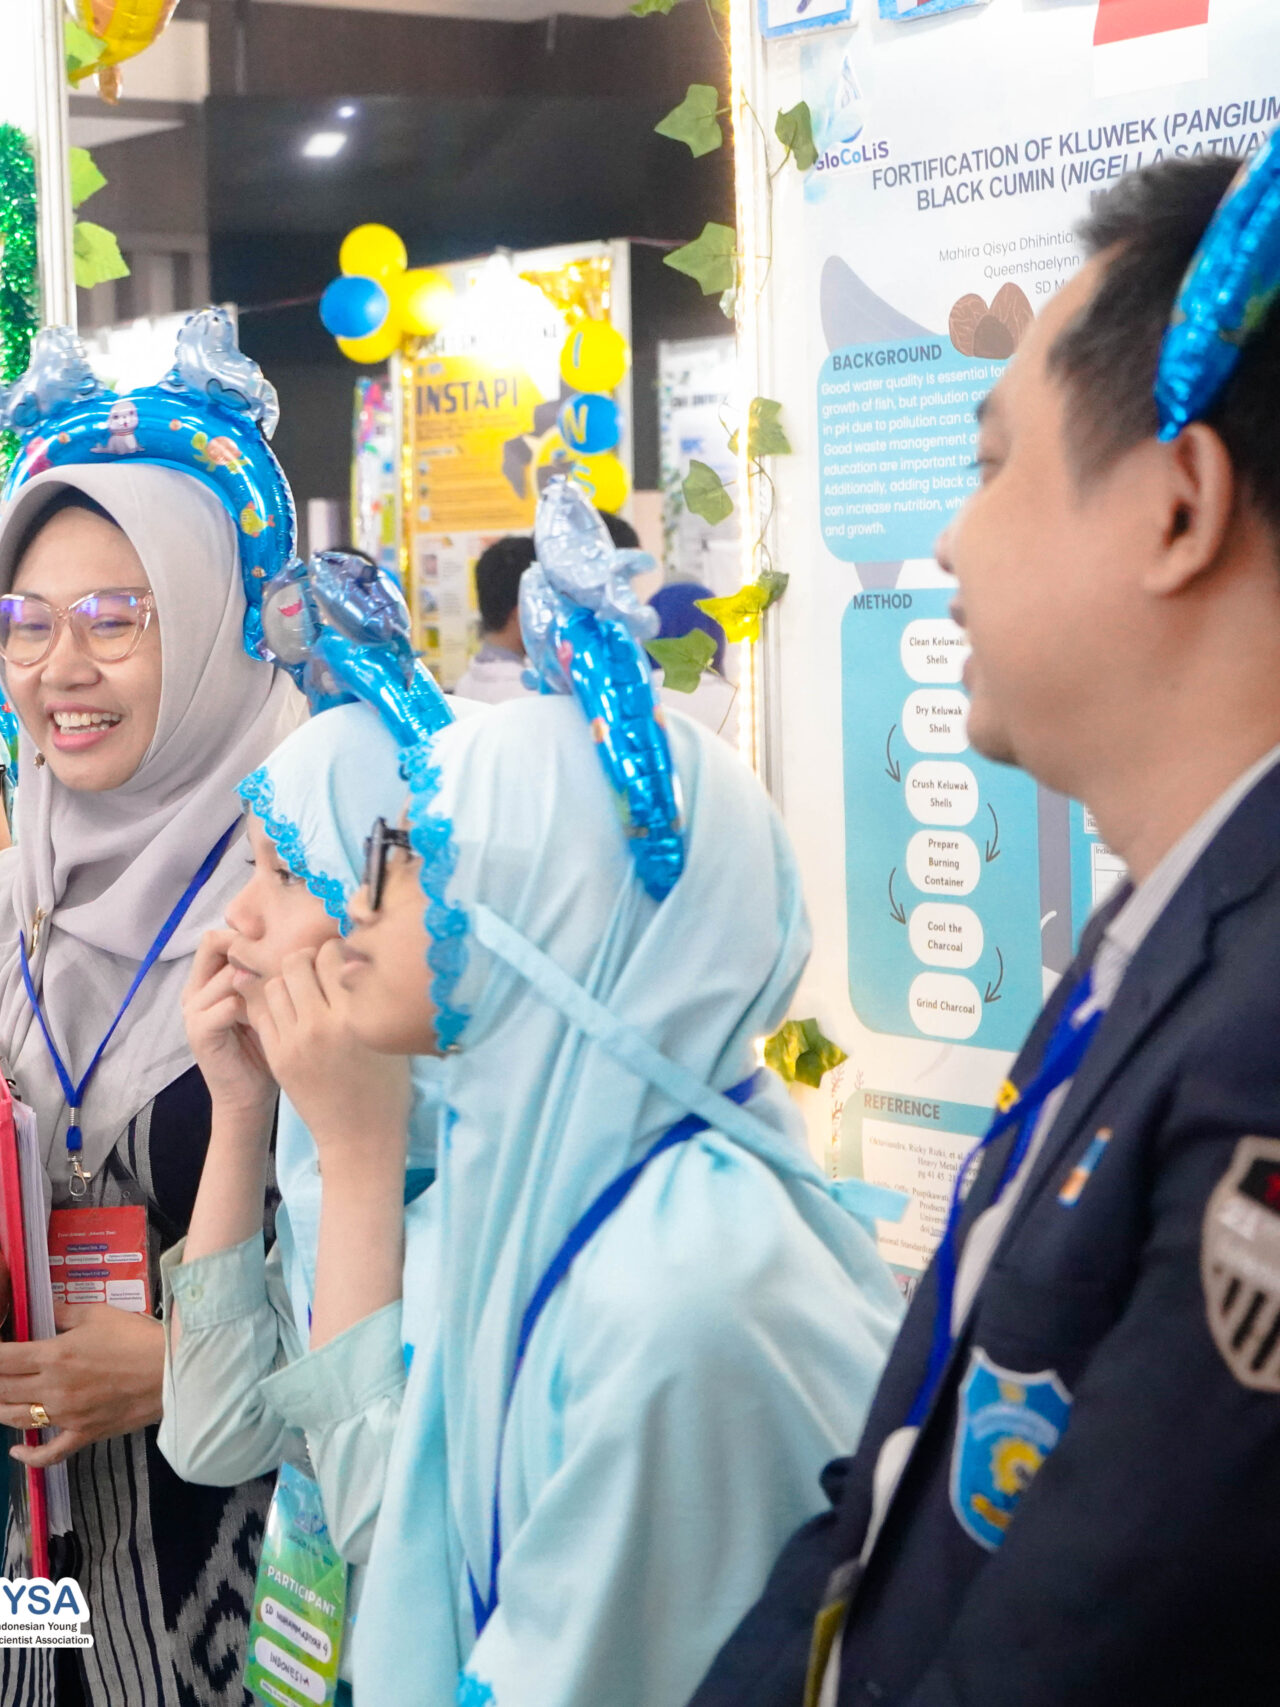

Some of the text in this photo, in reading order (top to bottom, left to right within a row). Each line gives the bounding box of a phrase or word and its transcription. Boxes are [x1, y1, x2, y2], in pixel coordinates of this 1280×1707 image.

[872, 142, 1019, 190] FORTIFICATION
[1024, 137, 1053, 162] OF
[1059, 117, 1157, 156] KLUWEK
[917, 179, 984, 211] BLACK
[989, 167, 1055, 198] CUMIN
[939, 246, 980, 262] Mahira
[983, 240, 1016, 257] Qisya
[983, 254, 1080, 280] Queenshaelynn
[1035, 281, 1052, 295] SD
[832, 344, 943, 371] BACKGROUND
[821, 381, 850, 396] Good
[852, 378, 883, 392] water
[886, 373, 924, 389] quality
[926, 373, 935, 385] is
[937, 365, 989, 384] essential
[415, 377, 518, 416] INSTAPI
[822, 398, 860, 418] growth
[861, 397, 873, 412] of
[898, 394, 917, 408] but
[920, 390, 968, 410] pollution
[823, 421, 833, 436] in
[835, 420, 850, 438] pH
[852, 418, 872, 433] due
[875, 418, 886, 432] to
[889, 413, 937, 434] pollution
[939, 413, 961, 426] can
[824, 442, 852, 457] Good
[854, 440, 887, 454] waste
[889, 433, 967, 452] management
[824, 454, 970, 476] education are important to
[890, 478, 929, 494] adding
[932, 475, 963, 489] black
[824, 505, 844, 517] can
[846, 502, 891, 514] increase
[894, 498, 942, 513] nutrition,
[825, 523, 845, 537] and
[853, 593, 913, 610] METHOD
[909, 637, 930, 647] Clean
[926, 655, 948, 665] Shells
[916, 705, 963, 717] Dry Keluwak
[929, 724, 951, 734] Shells
[912, 779, 969, 791] Crush Keluwak
[930, 798, 952, 808] Shells
[928, 838, 959, 852] Prepare
[928, 857, 960, 871] Burning
[924, 875, 964, 888] Container
[927, 921, 963, 934] Cool the
[927, 939, 963, 953] Charcoal
[916, 998, 976, 1015] Grind Charcoal
[863, 1093, 941, 1120] REFERENCE
[267, 1565, 336, 1618] PARTICIPANT
